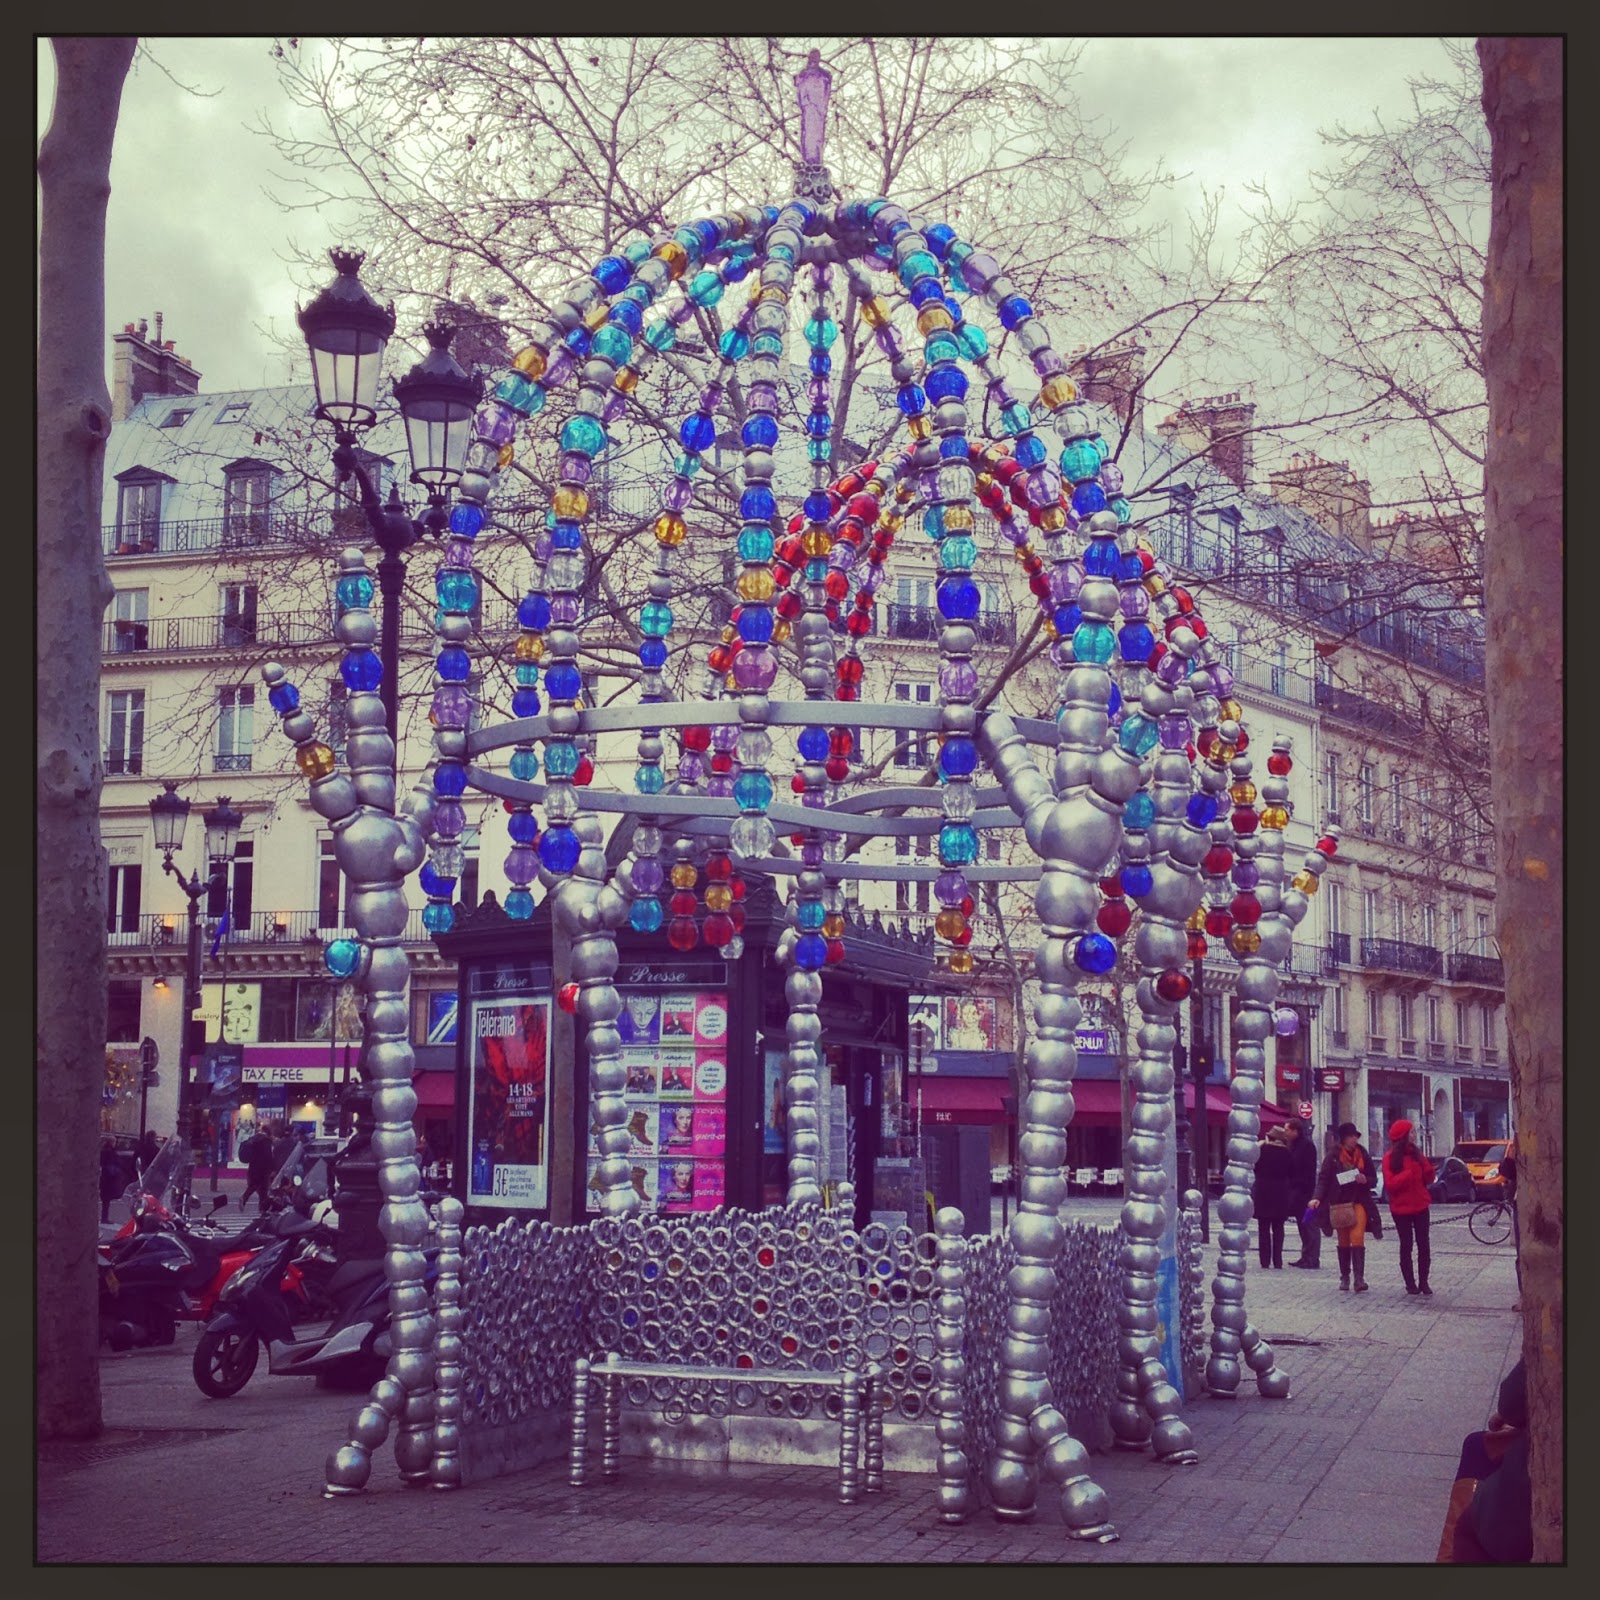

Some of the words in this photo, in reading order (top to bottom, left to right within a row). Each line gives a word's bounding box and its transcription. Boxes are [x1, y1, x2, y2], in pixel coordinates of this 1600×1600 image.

[494, 972, 528, 988] Presse
[630, 967, 687, 983] Presse
[477, 1010, 516, 1037] Télérama
[1075, 1036, 1104, 1050] BENLUX
[243, 1069, 266, 1080] TAX
[271, 1069, 304, 1080] FREE
[494, 1168, 509, 1197] 3€
